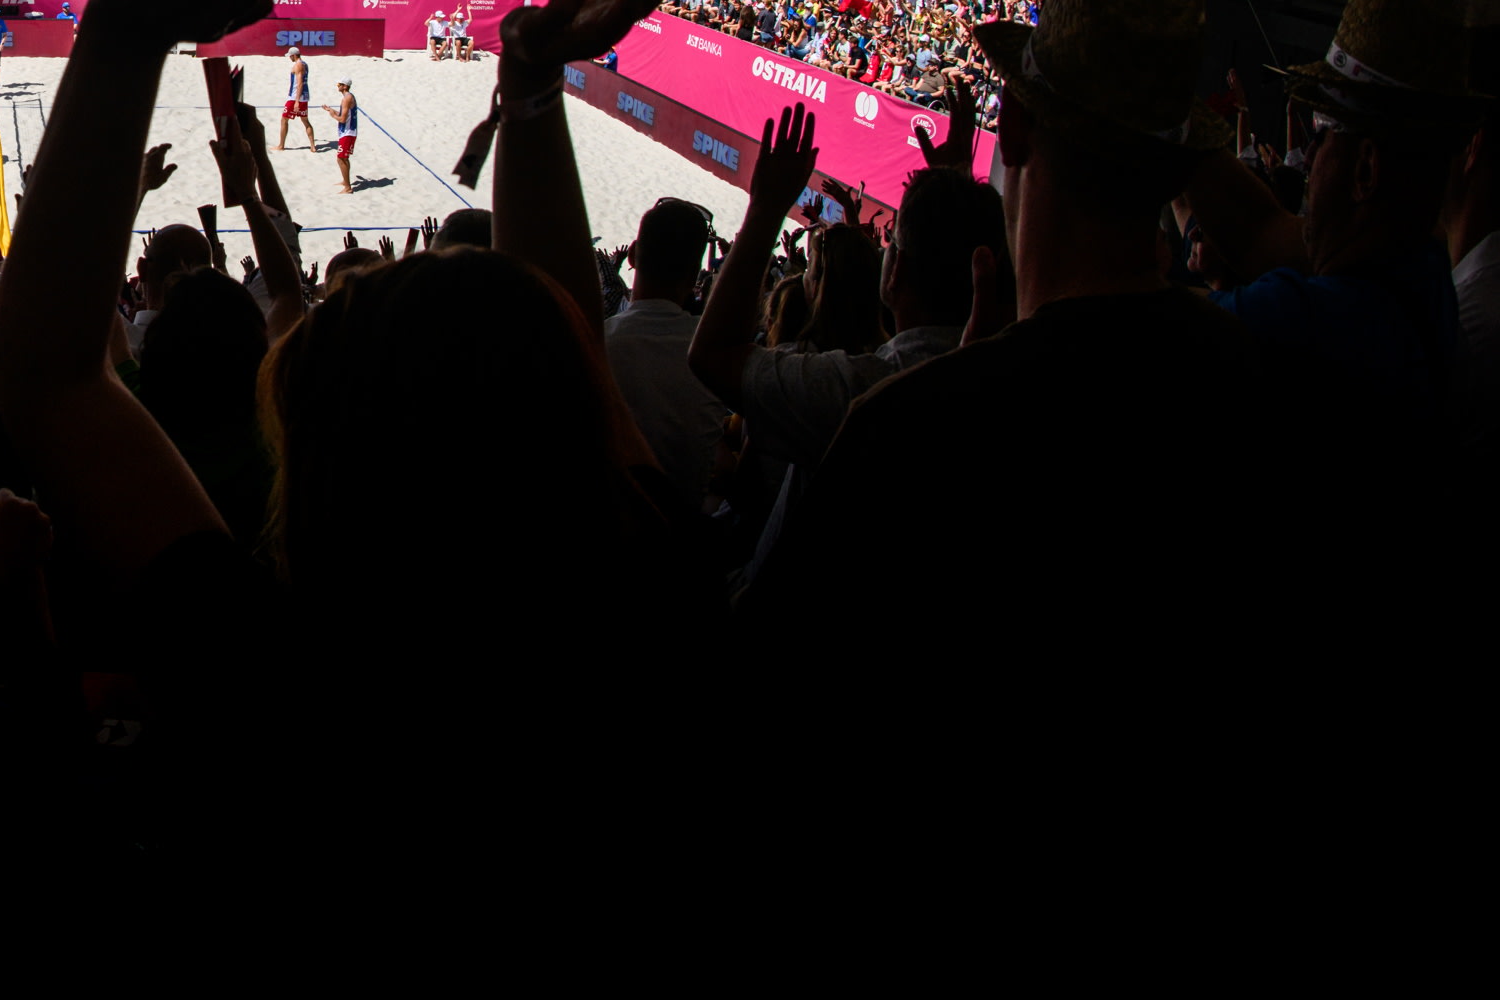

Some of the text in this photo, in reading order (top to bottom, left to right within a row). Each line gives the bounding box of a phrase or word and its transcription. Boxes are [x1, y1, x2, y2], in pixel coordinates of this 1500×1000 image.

[275, 30, 336, 47] SPIKE
[638, 19, 662, 35] Senoh
[752, 56, 827, 103] OSTRAVA
[616, 91, 655, 121] SPIKE
[692, 129, 740, 171] SPIKE
